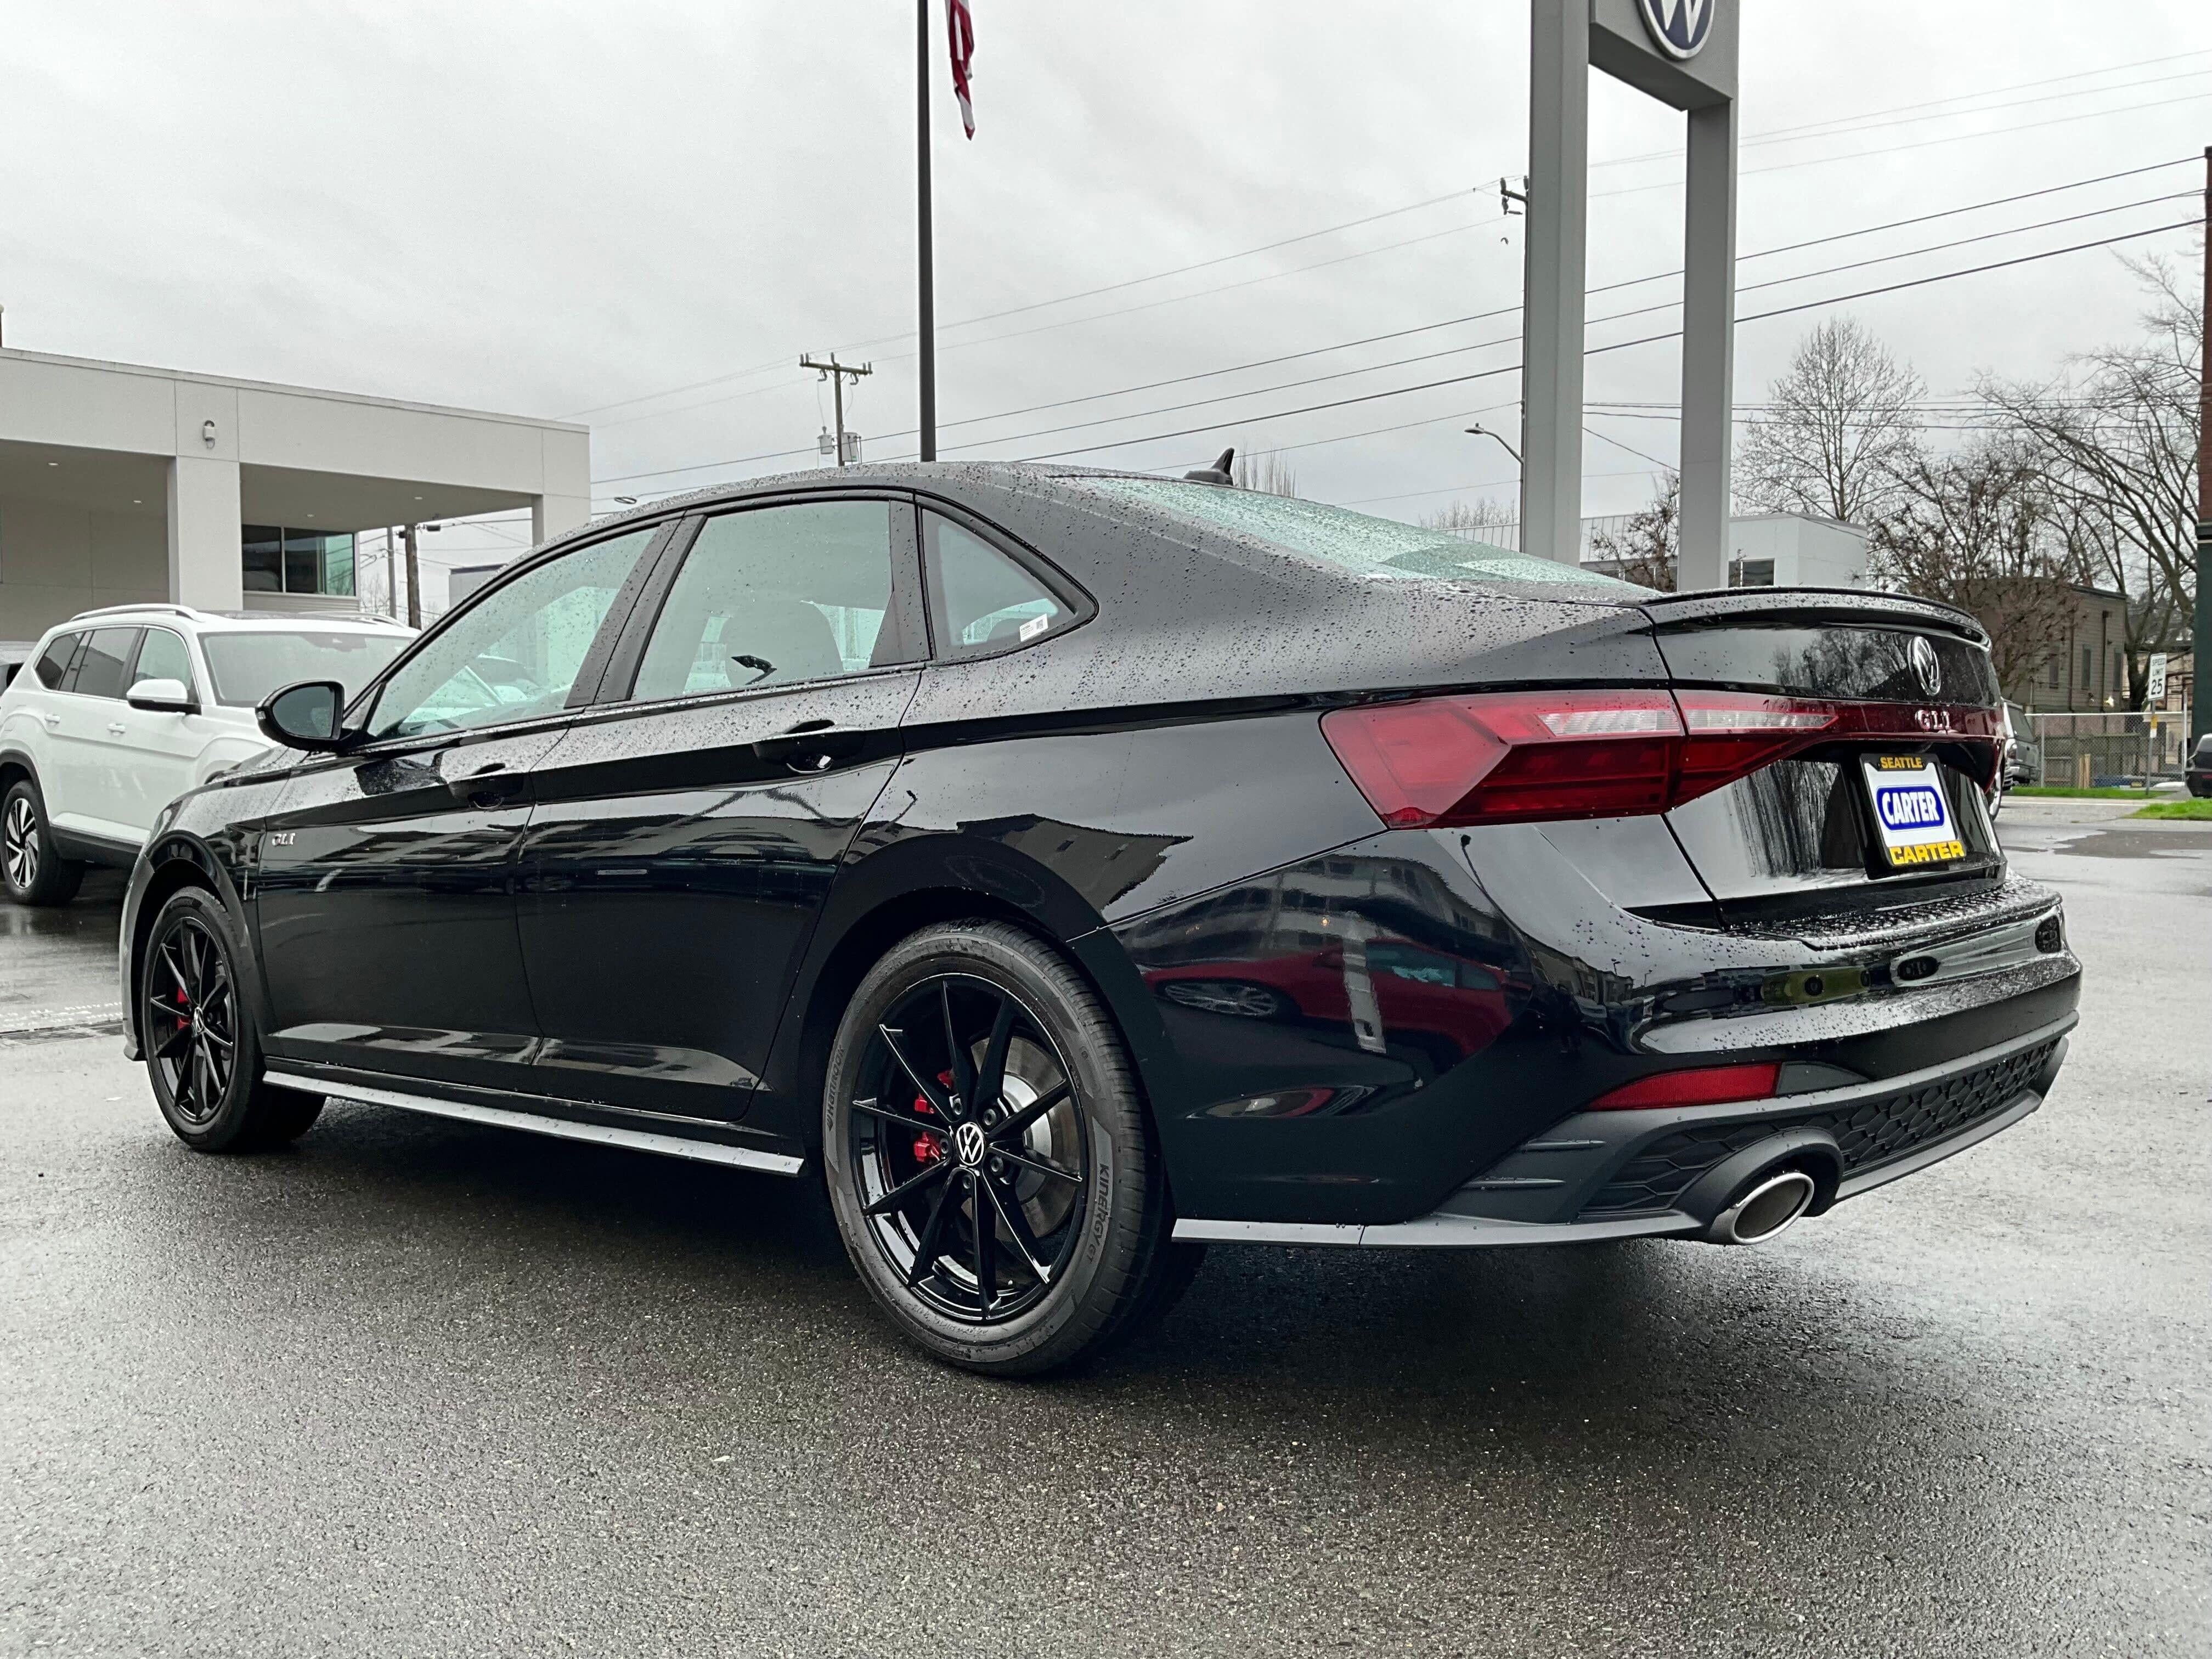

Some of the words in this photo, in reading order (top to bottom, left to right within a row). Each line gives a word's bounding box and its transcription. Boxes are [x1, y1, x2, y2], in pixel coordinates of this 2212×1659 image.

[2152, 658, 2166, 666] SPEED
[2152, 668, 2163, 676] LIMIT
[2151, 678, 2163, 695] 25
[1915, 709, 1950, 730] GLI
[1880, 757, 1923, 769] SEATTLE
[1882, 791, 1940, 825] CARTER
[272, 833, 296, 846] GLI
[1889, 840, 1965, 865] CARTER
[1093, 1163, 1110, 1246] KINERGY
